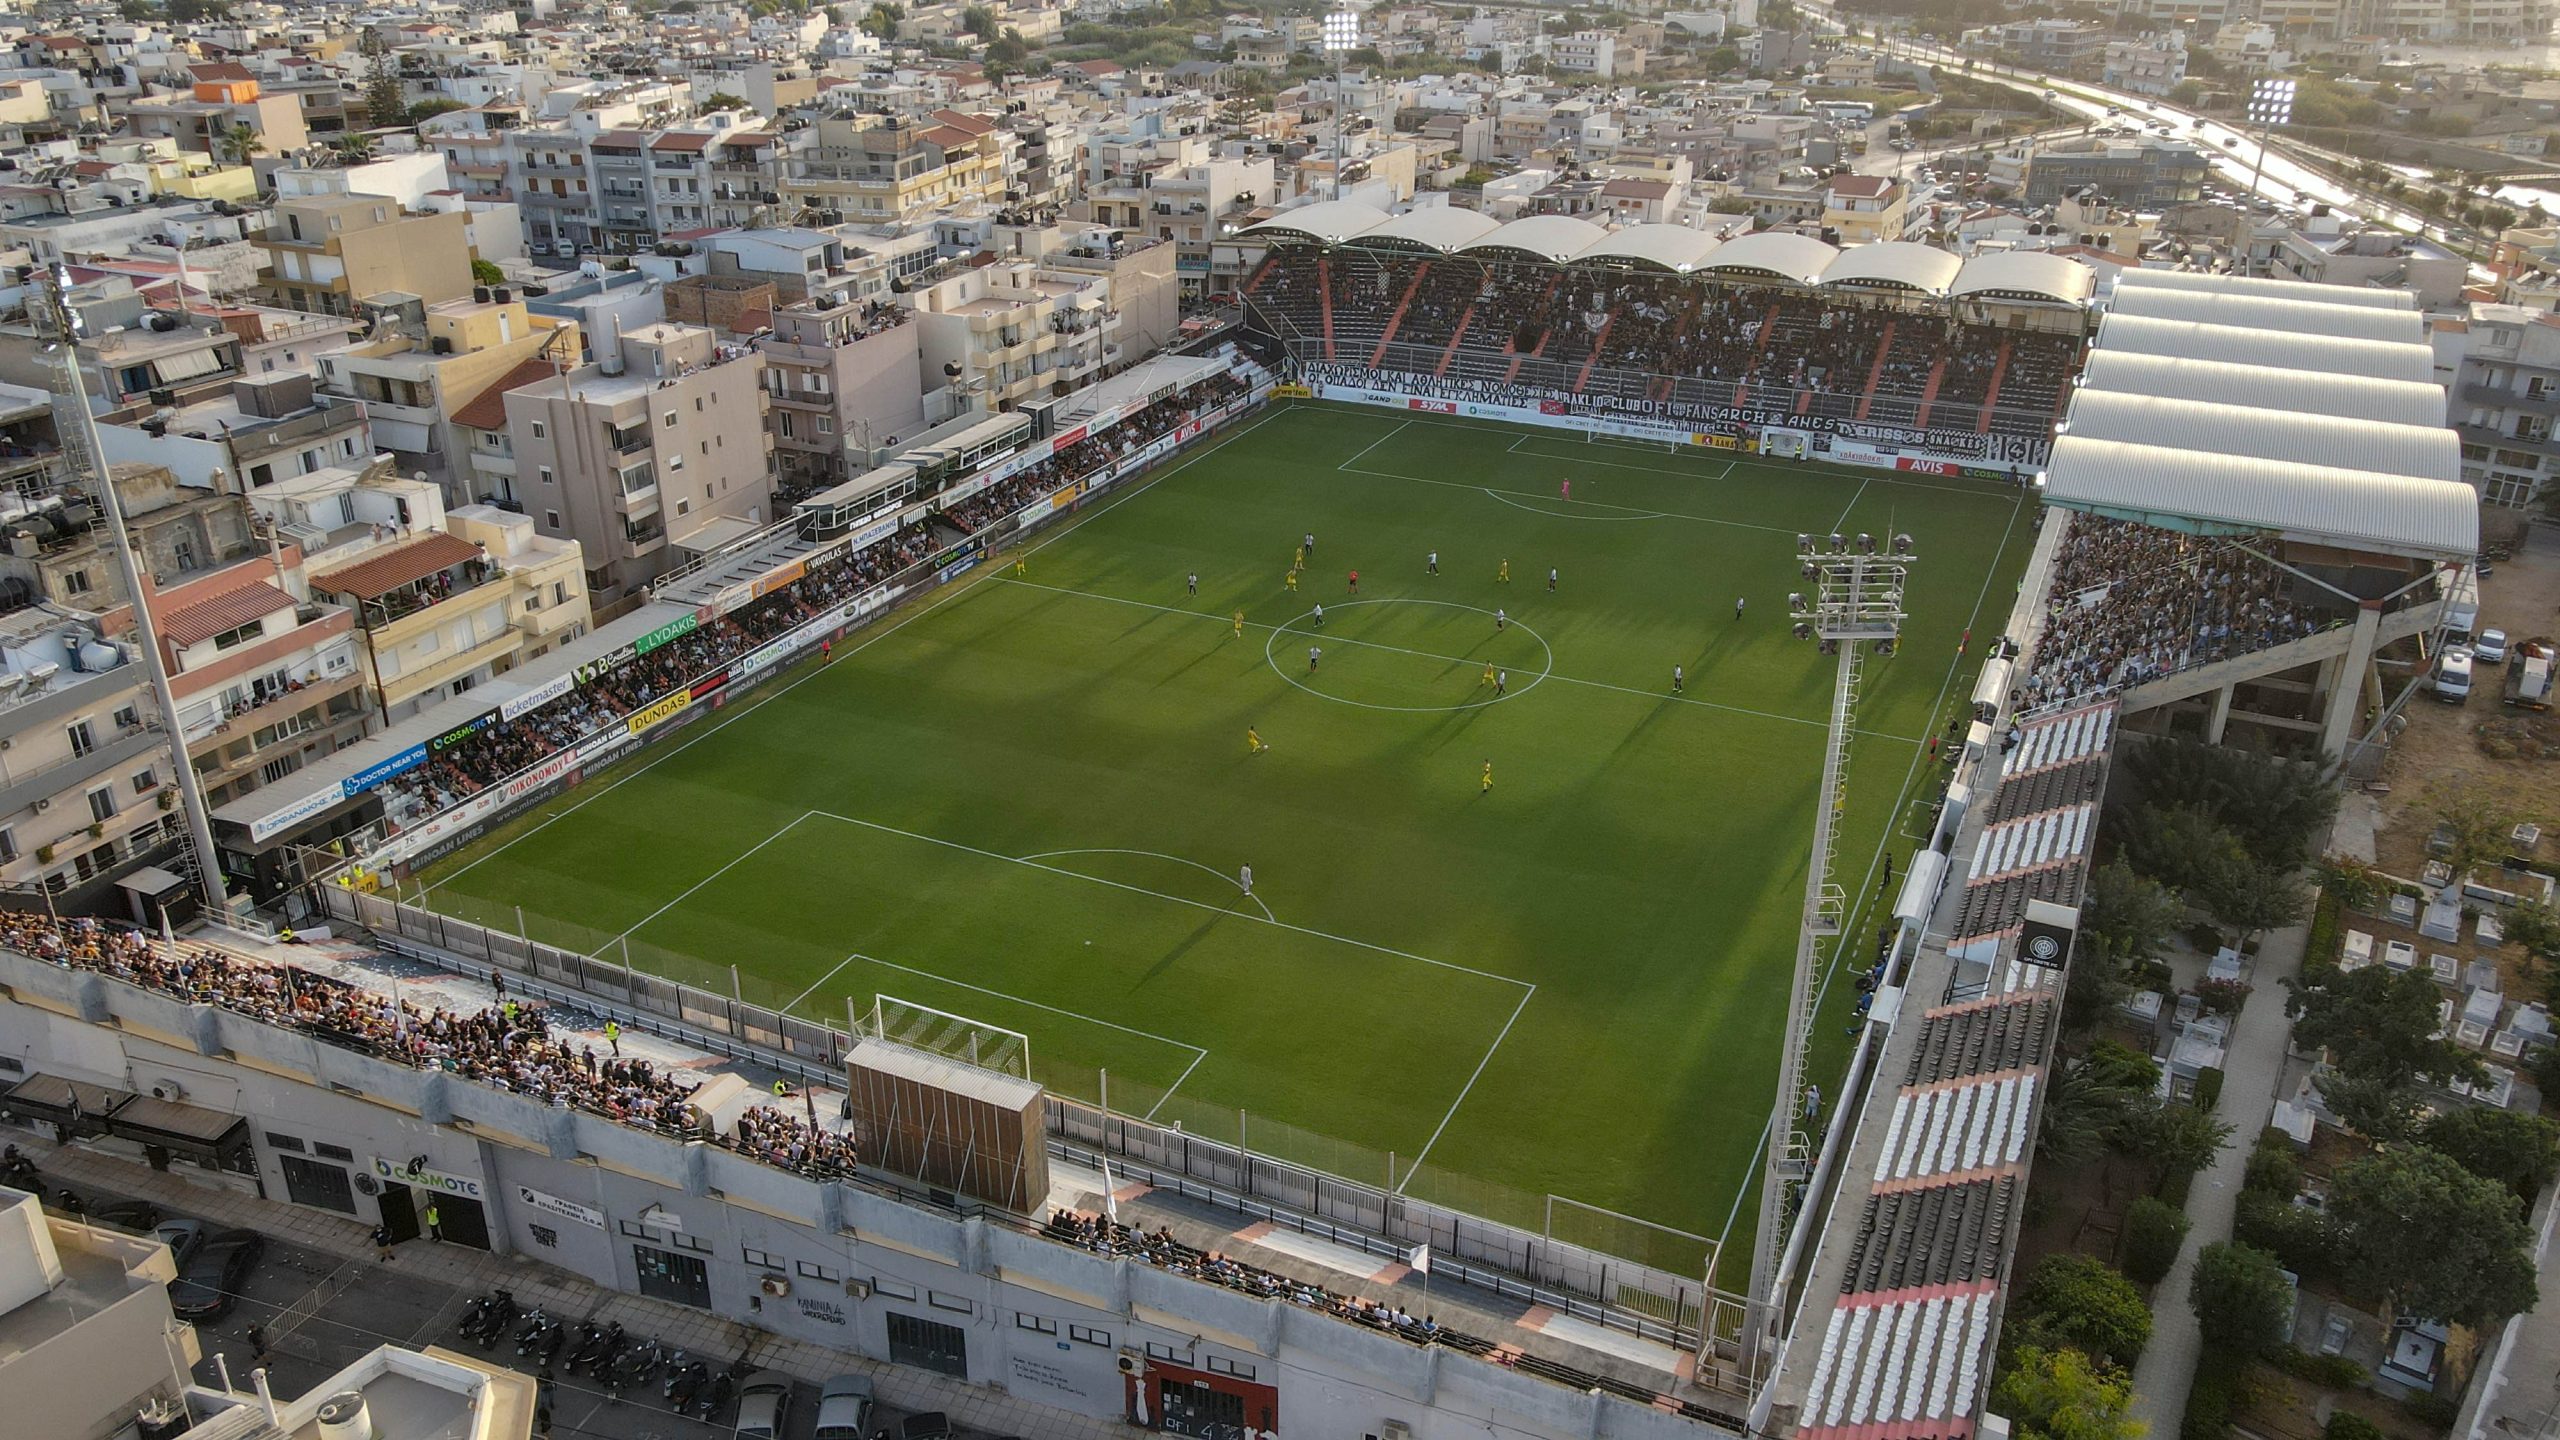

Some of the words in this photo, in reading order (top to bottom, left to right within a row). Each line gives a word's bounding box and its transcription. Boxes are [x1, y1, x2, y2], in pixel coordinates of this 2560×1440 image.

[1388, 371, 1406, 383] ΚΑΙ
[1419, 400, 1449, 411] SYM
[1611, 397, 1640, 412] CLUB
[1686, 403, 1718, 420] FANS
[1180, 423, 1196, 440] AVIS
[1909, 459, 1945, 474] AVIS
[1973, 470, 2014, 482] COSMOT
[810, 547, 842, 569] VAVOULAS
[648, 615, 697, 647] LYDAKIS
[754, 639, 793, 665] COSMOTE
[504, 678, 568, 720] ticketmaster
[634, 695, 686, 730] DUNDAS
[575, 734, 606, 758] MINOAN
[606, 723, 629, 744] LINES
[360, 766, 391, 785] DOCTOR
[392, 756, 412, 771] NEAR
[411, 747, 427, 761] YOU
[582, 750, 620, 777] MINOAN
[620, 739, 644, 757] LINES
[496, 784, 560, 823] www.minoan.gr
[409, 840, 455, 871] MINOAN
[456, 825, 485, 846] LINES
